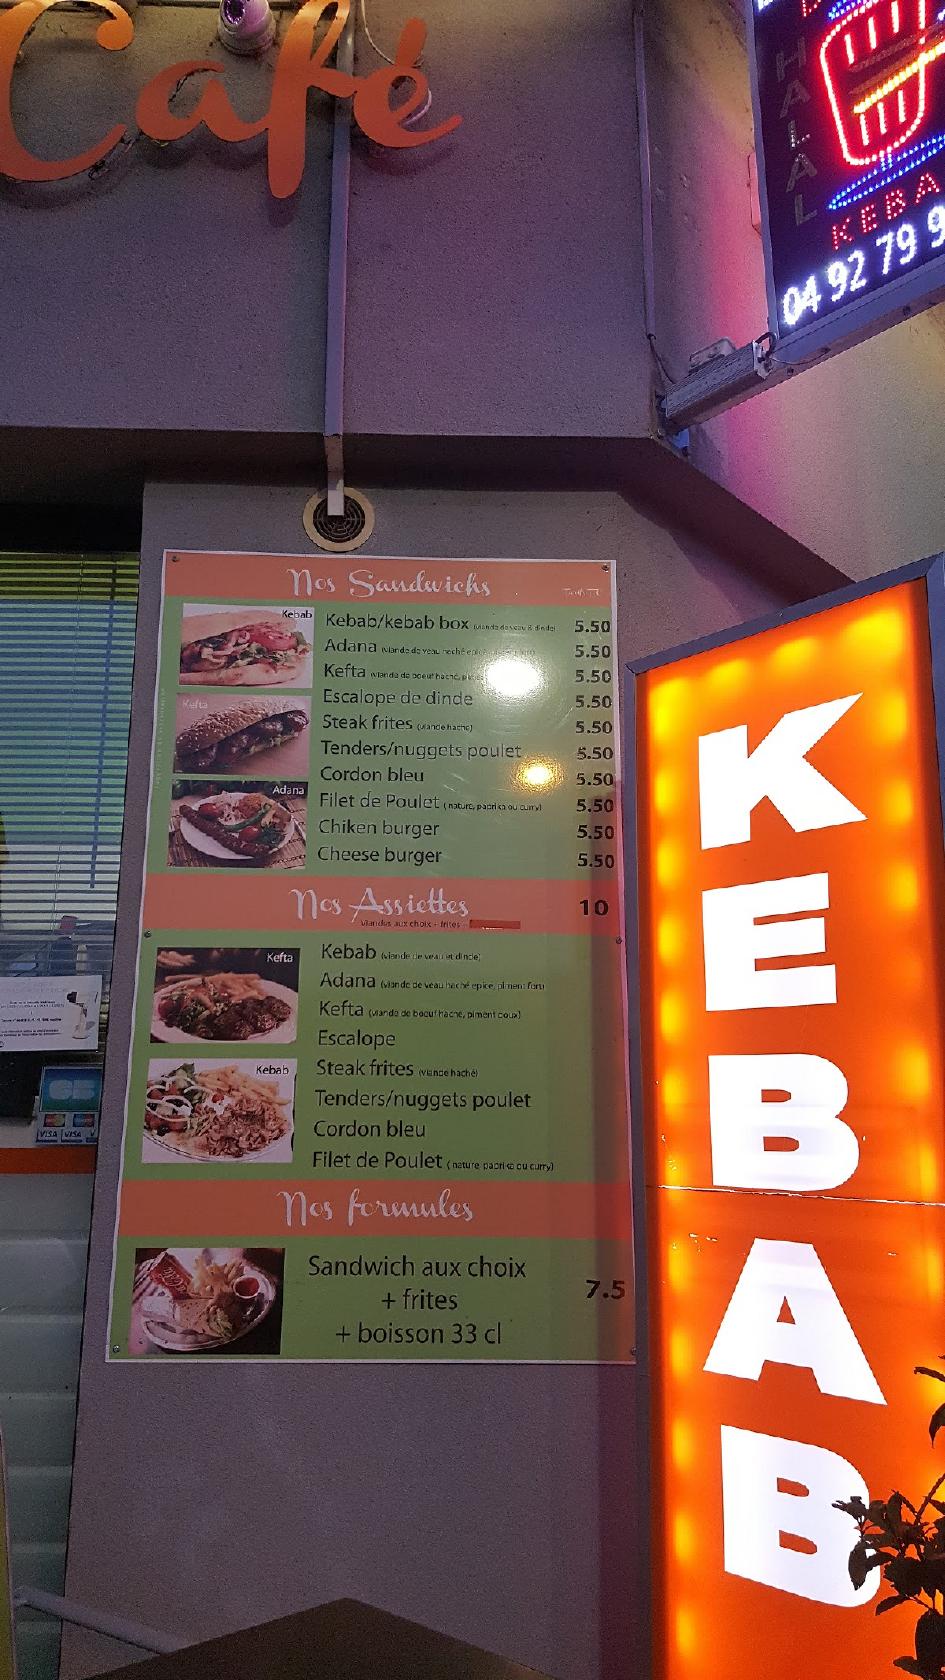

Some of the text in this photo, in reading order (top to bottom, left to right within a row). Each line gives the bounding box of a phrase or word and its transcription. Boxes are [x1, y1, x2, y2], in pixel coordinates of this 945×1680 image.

[0, 0, 463, 199] Café
[782, 274, 821, 326] 04
[827, 249, 867, 302] 92
[876, 222, 917, 275] 79
[287, 567, 492, 598] Nos Sandwichs
[282, 609, 313, 619] Kebab
[326, 613, 434, 630] Kebab/kebab
[440, 615, 469, 630] box
[574, 620, 610, 633] 5.50
[324, 638, 377, 653] Adana
[575, 645, 611, 658] 5.50
[323, 664, 366, 678] Kefta
[575, 670, 611, 683] 5.50
[182, 699, 208, 710] Kefta
[323, 689, 473, 707] Escalope de dinde
[575, 695, 612, 708] 5.50
[322, 714, 367, 730] Steak
[372, 715, 413, 730] frites
[576, 720, 613, 734] 5.50
[321, 740, 522, 761] Tenders/nuggets poulet
[576, 747, 614, 760] 5.50
[320, 766, 425, 782] Cordon bleu
[576, 772, 614, 786] 5.50
[272, 784, 305, 795] Adana
[320, 792, 355, 808] Filet
[360, 792, 381, 808] de
[386, 793, 440, 809] Poulet
[576, 798, 614, 813] 5.50
[319, 819, 440, 839] Chiken burger
[576, 824, 615, 840] 5.50
[317, 846, 442, 867] Cheese burger
[577, 853, 615, 868] 5.50
[289, 887, 469, 923] Nos Assiettes
[579, 899, 609, 916] 10
[267, 952, 294, 963] Kefta
[321, 943, 376, 960] Kebab
[320, 973, 376, 989] Adana
[319, 1001, 364, 1017] Kefta
[317, 1030, 396, 1051] Escalope
[256, 1064, 289, 1075] Kebab
[316, 1059, 365, 1076] Steak
[370, 1060, 414, 1076] frites
[315, 1089, 531, 1111] Tenders/nuggets poulet
[40, 1130, 58, 1138] VISA
[64, 1130, 82, 1138] VISA
[313, 1120, 426, 1138] Cordon bleu
[698, 692, 887, 1607] KEBAB
[312, 1151, 350, 1168] Filet
[356, 1151, 379, 1168] de
[385, 1152, 442, 1169] Poulet
[276, 1188, 474, 1226] Nos formules
[308, 1255, 527, 1278] Sandwich aux choix
[585, 1279, 626, 1299] 7.5
[403, 1288, 458, 1309] frites
[358, 1322, 444, 1344] boisson
[451, 1323, 477, 1344] 33
[484, 1322, 501, 1344] cl
